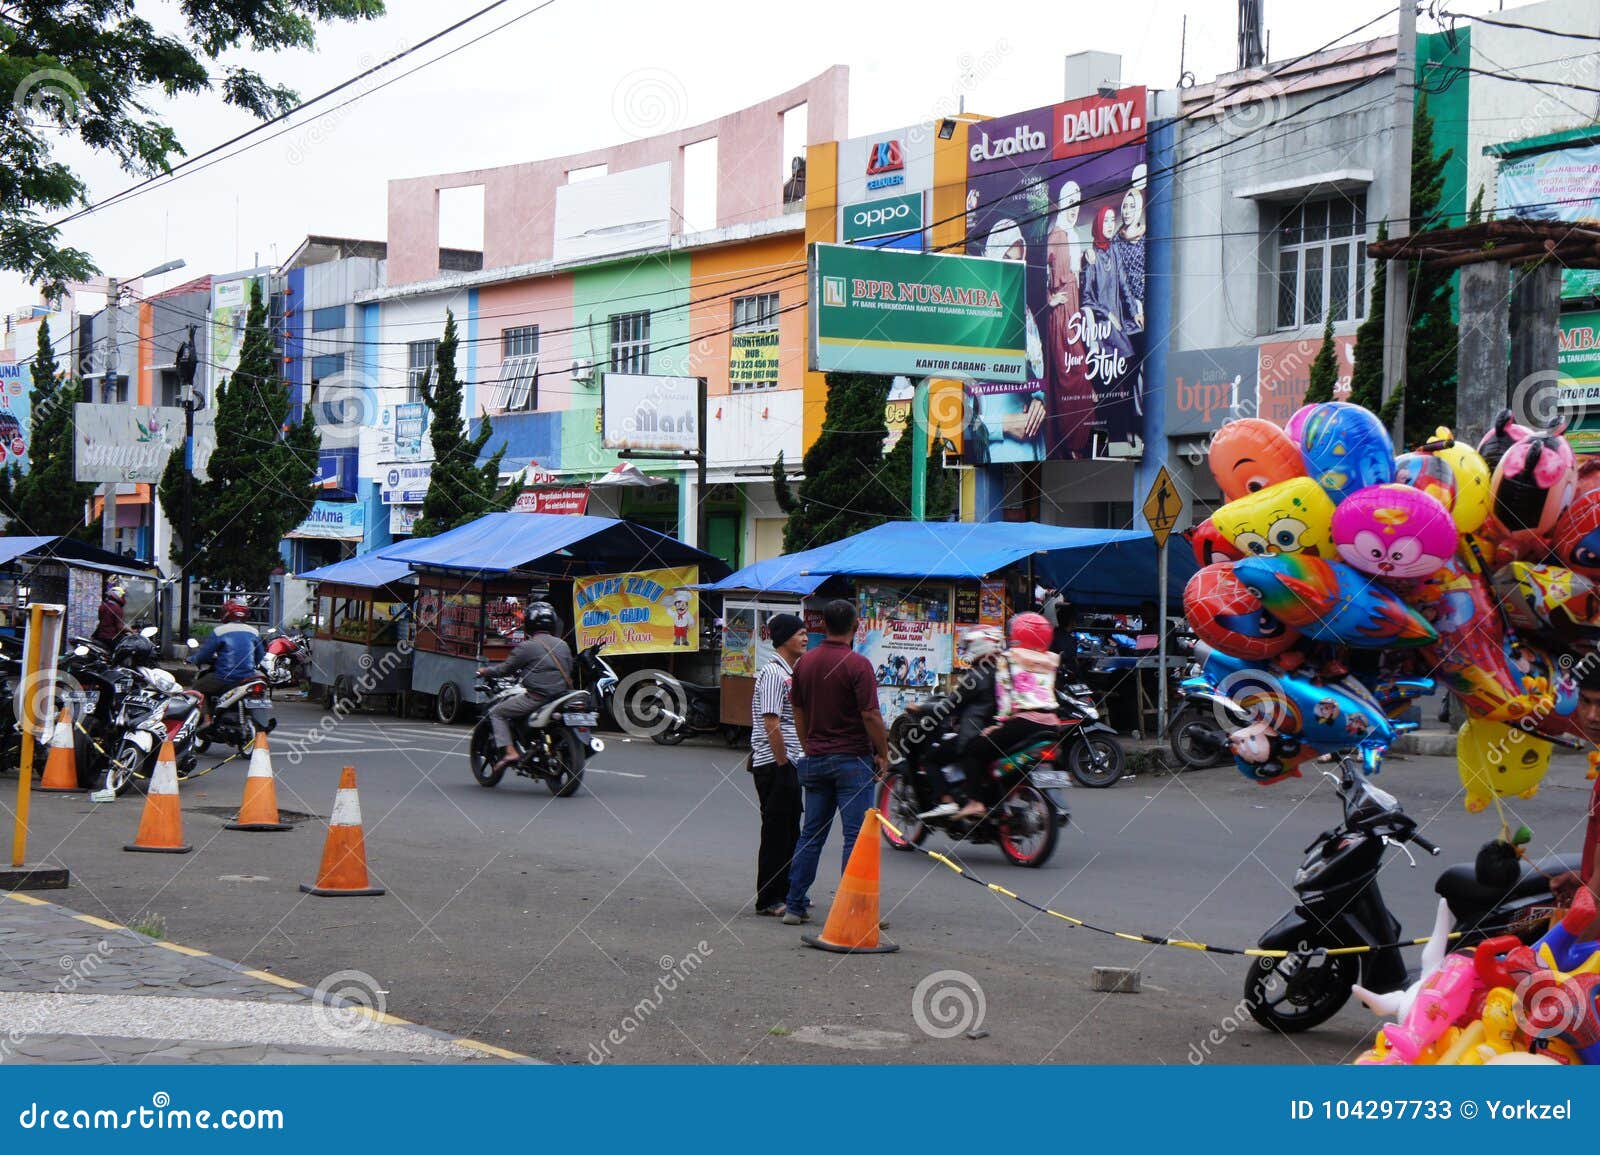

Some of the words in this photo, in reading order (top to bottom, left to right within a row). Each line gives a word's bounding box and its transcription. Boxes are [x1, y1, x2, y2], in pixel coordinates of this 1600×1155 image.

[854, 204, 910, 227] oppo
[852, 279, 896, 300] BPR
[898, 283, 1003, 308] NUSAMBA
[938, 307, 965, 315] NUSAMBA
[1067, 308, 1112, 345] Show
[916, 359, 950, 370] KANTOR
[951, 360, 986, 371] CABANG
[992, 364, 1022, 374] GARUT
[1085, 349, 1127, 385] Style
[636, 408, 694, 432] Mart
[625, 578, 665, 603] TAHU
[582, 609, 611, 627] GADO
[619, 606, 651, 624] GADO
[623, 626, 653, 643] Rasa
